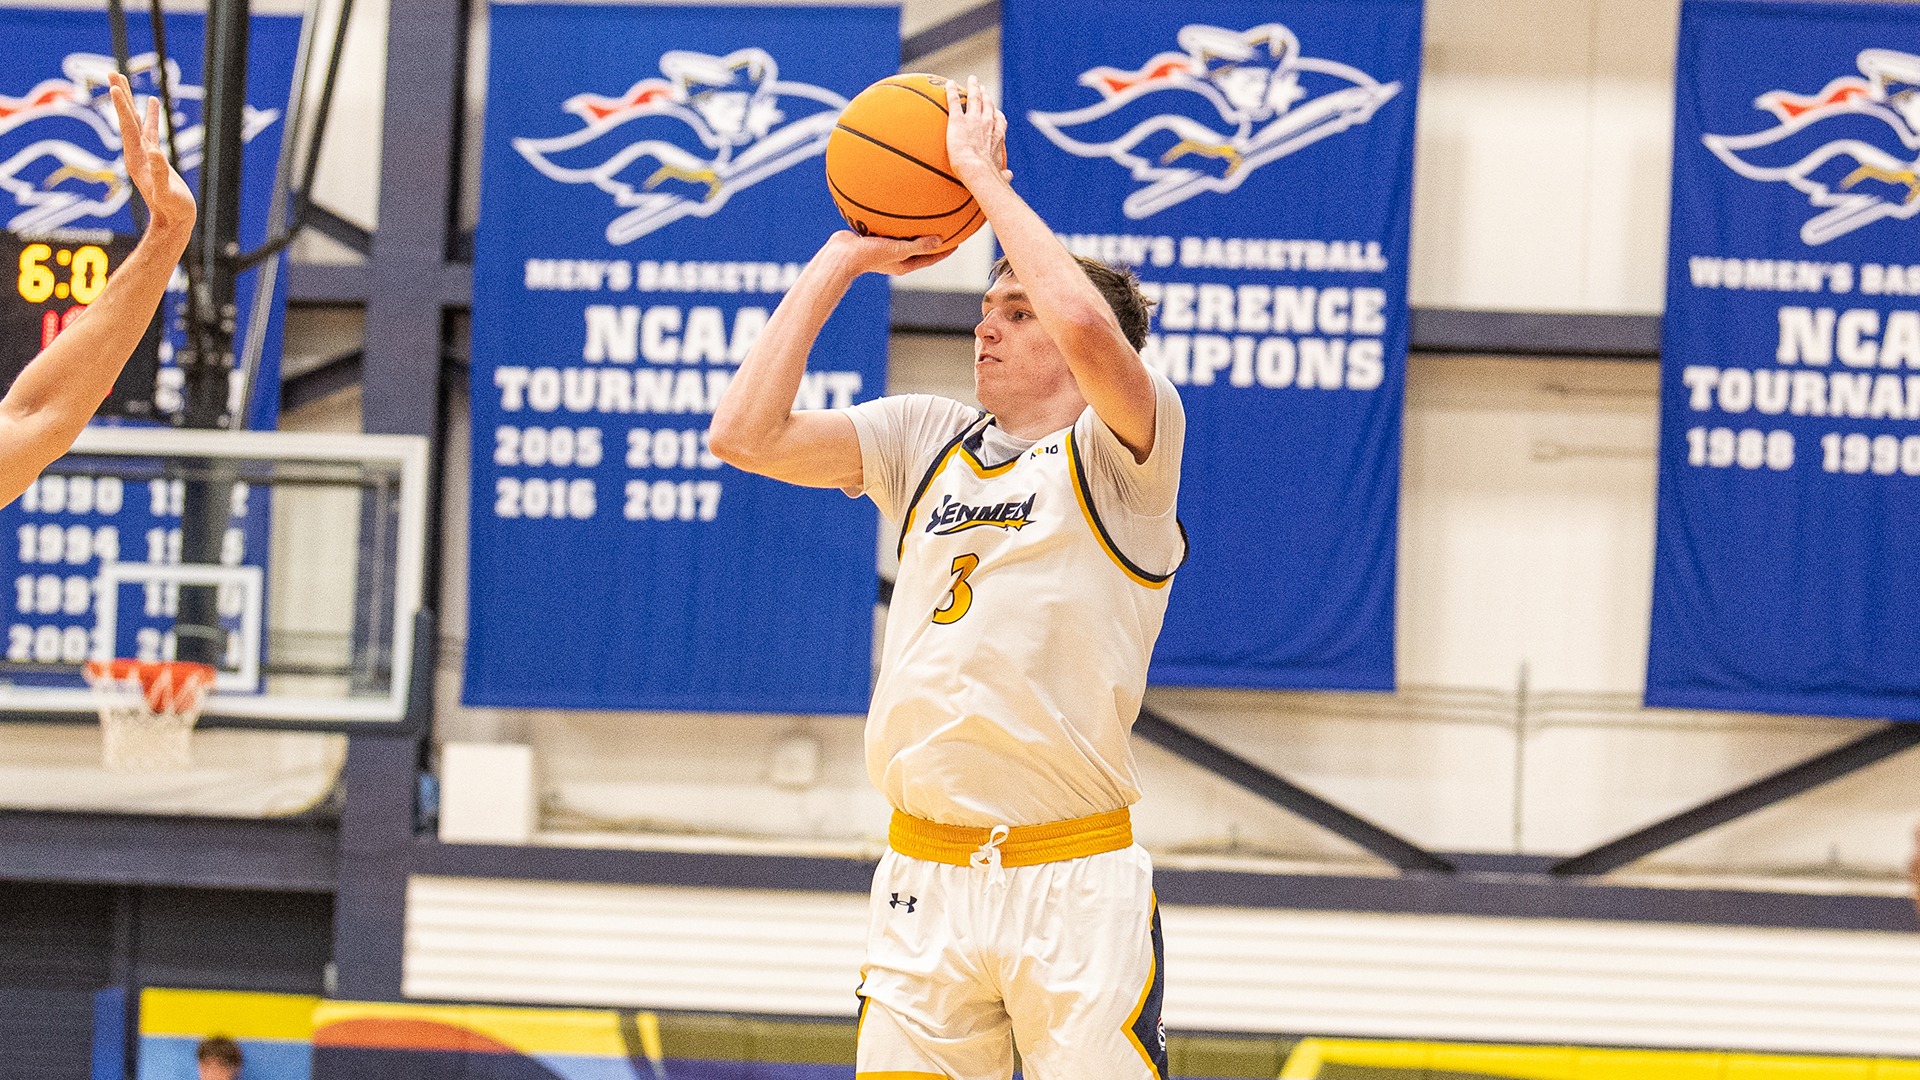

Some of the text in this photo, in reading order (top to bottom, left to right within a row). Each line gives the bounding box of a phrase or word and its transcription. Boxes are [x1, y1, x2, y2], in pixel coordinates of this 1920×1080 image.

[1054, 232, 1387, 272] MEN'S BASKETBALL
[525, 259, 806, 293] MEN'S BASKETBA
[1689, 257, 1853, 294] WOMEN'S
[1139, 282, 1385, 335] ERENCE
[1141, 334, 1384, 390] MPIONS
[495, 367, 863, 414] TOURNANT
[494, 426, 602, 467] 2005
[495, 478, 721, 521] 2016 2017
[15, 574, 104, 616] 199
[932, 553, 979, 625] 3
